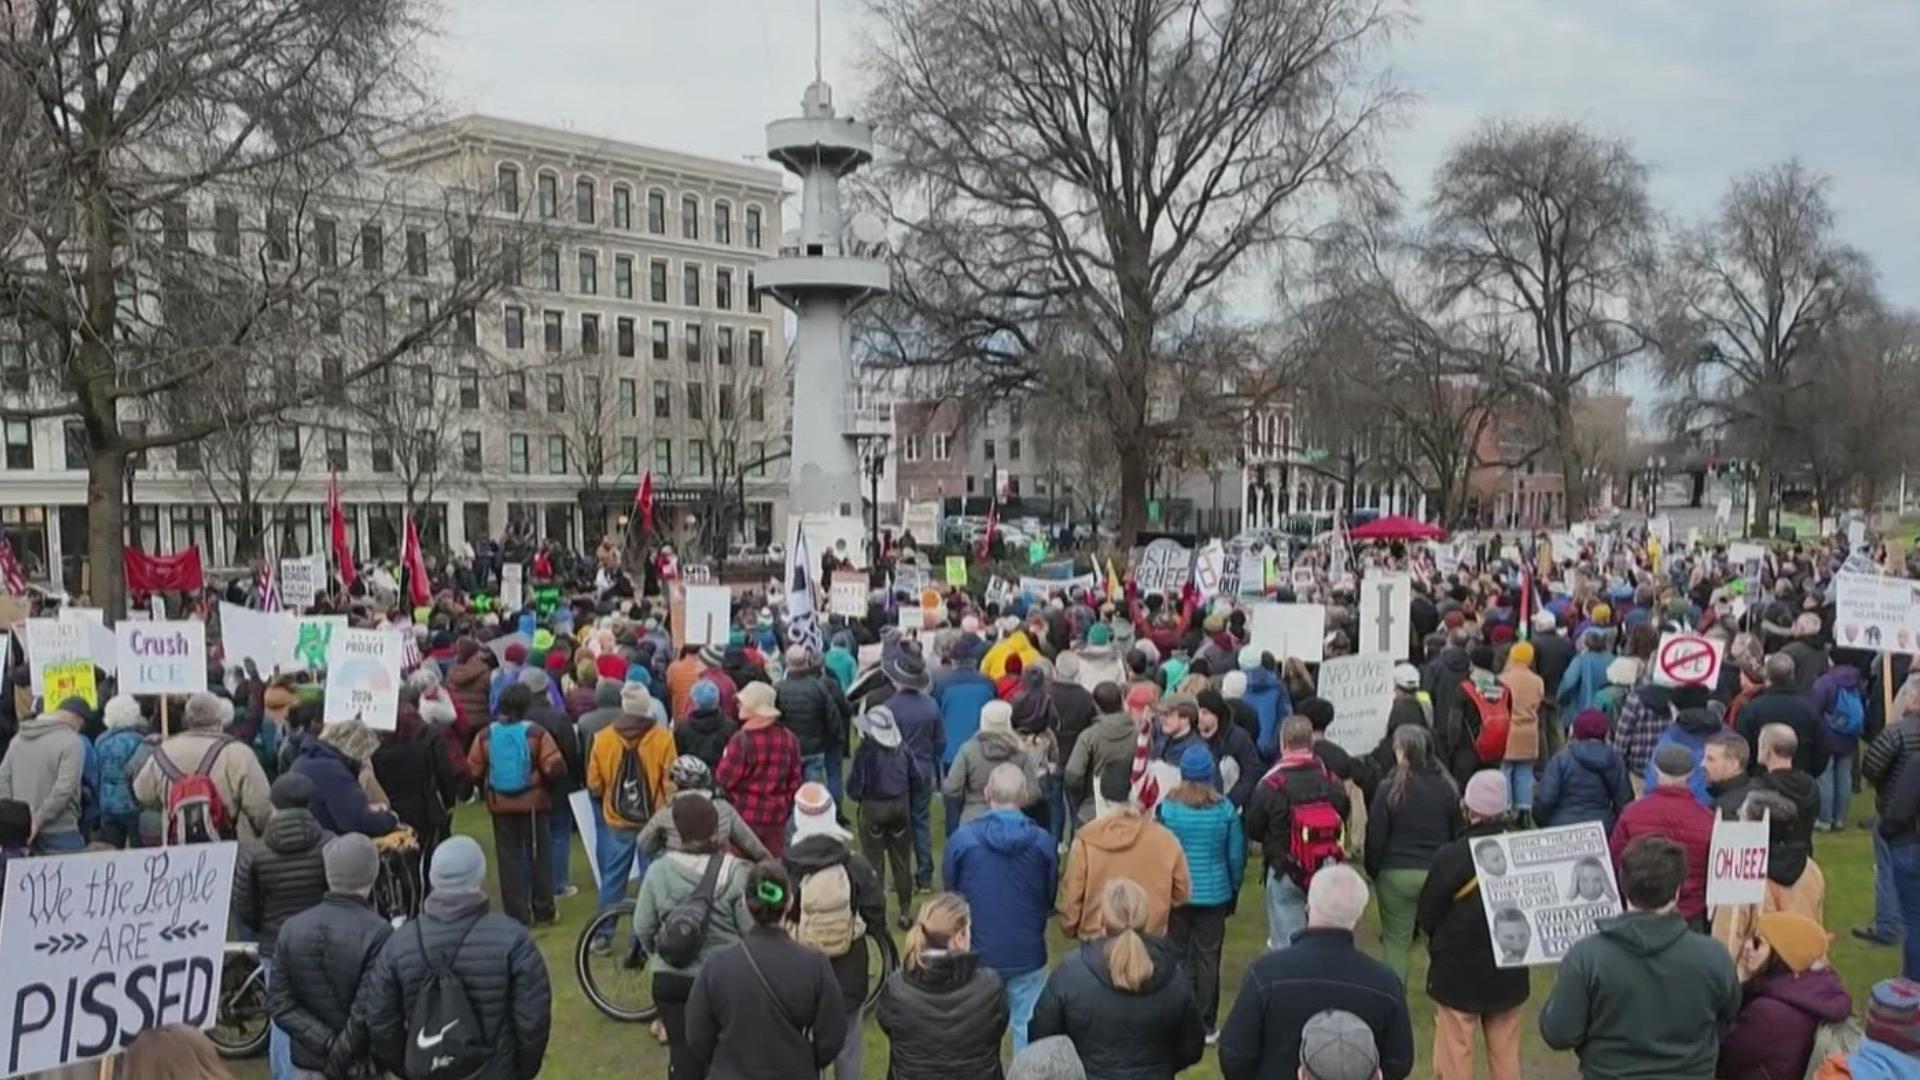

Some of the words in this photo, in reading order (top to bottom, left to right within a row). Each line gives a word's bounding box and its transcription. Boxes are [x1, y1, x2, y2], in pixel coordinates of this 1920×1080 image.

[652, 492, 701, 501] ORLDMARK
[1144, 547, 1182, 567] RIP
[1222, 556, 1240, 575] ICE
[1136, 567, 1188, 589] RENEE
[1218, 576, 1240, 594] OUT
[130, 629, 189, 656] Crush
[139, 664, 184, 682] ICE
[1714, 847, 1734, 879] OH
[1735, 847, 1768, 879] JEEZ
[20, 861, 73, 928] We
[84, 861, 135, 921] the
[133, 851, 218, 926] People
[1538, 907, 1580, 923] WHAT
[1585, 903, 1612, 918] DID
[1542, 921, 1583, 939] THEY
[91, 922, 154, 965] ARE
[8, 956, 214, 1074] PISSED
